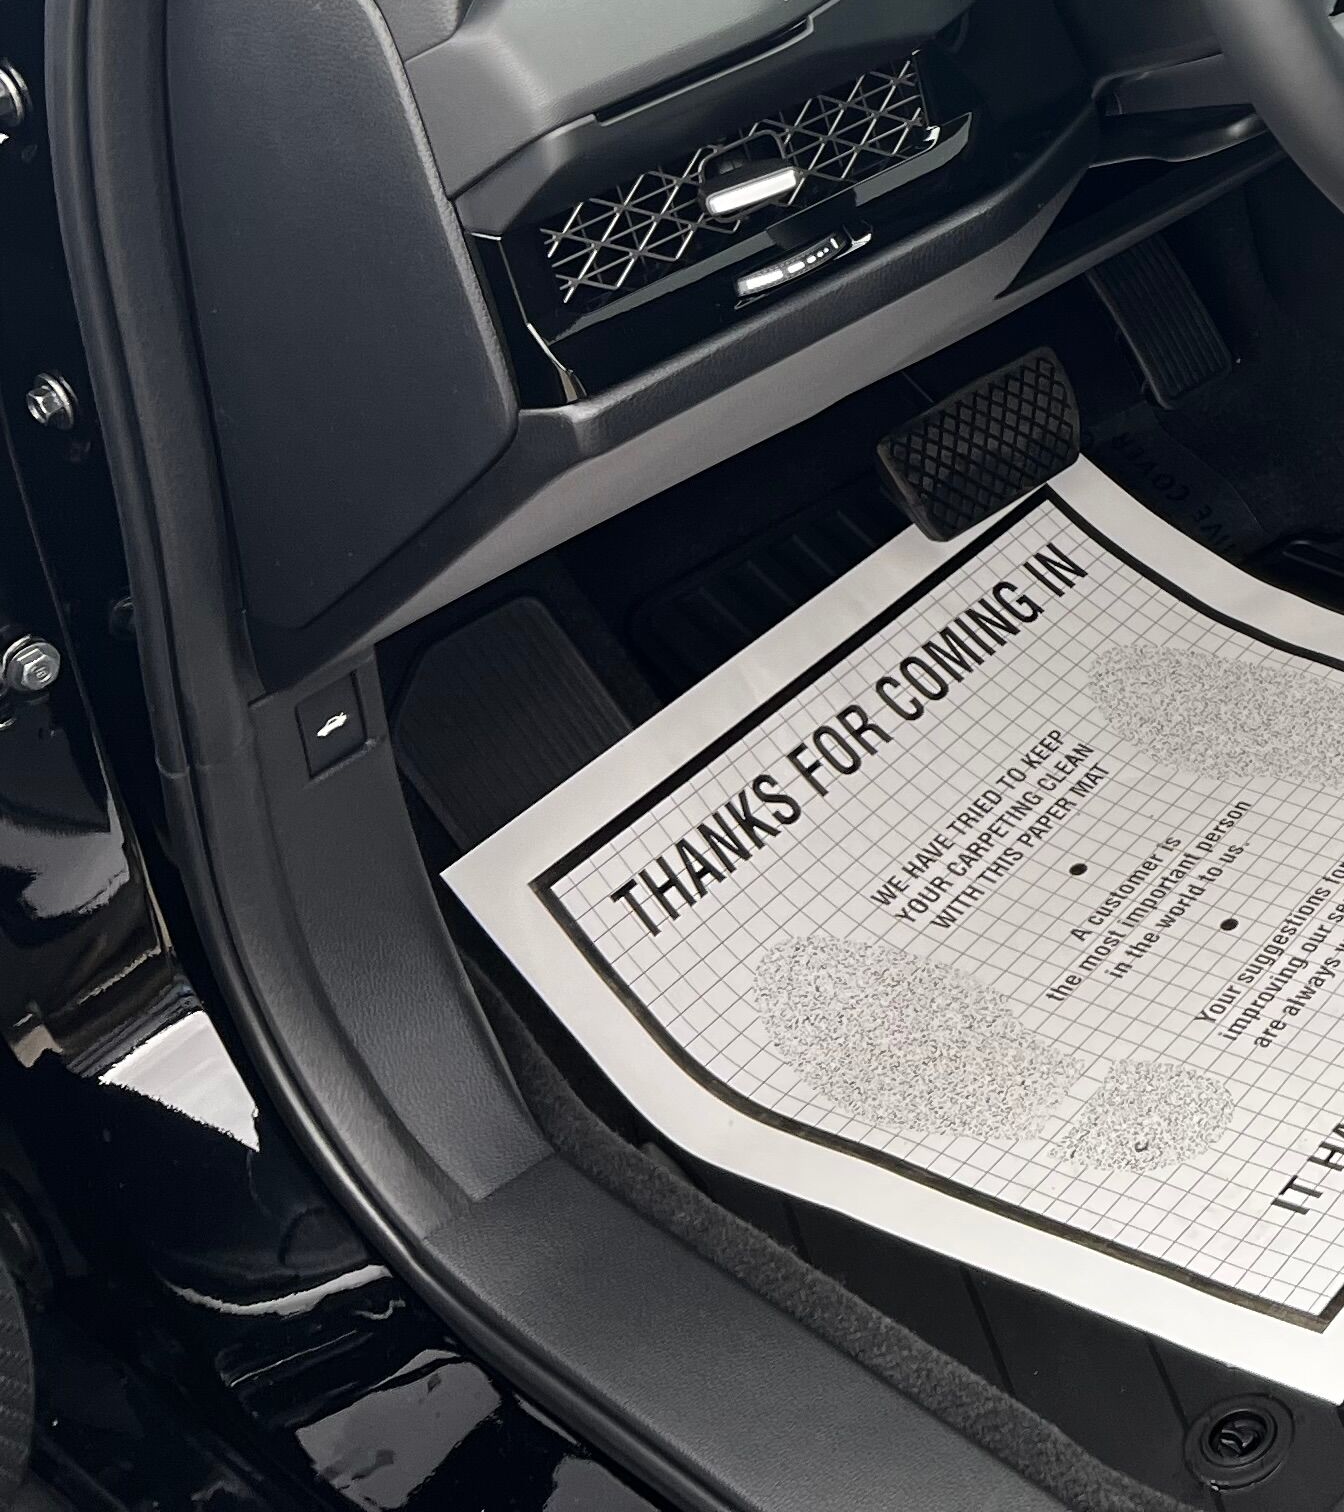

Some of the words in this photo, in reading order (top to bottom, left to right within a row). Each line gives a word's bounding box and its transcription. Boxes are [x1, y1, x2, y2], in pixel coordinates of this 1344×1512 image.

[611, 775, 801, 936] THANKS
[788, 705, 893, 797] FOR
[875, 581, 1044, 721] COMING
[1024, 543, 1088, 597] IN
[870, 875, 906, 906] WE
[902, 834, 955, 878] HAVE
[946, 790, 1003, 835] TRIED
[996, 767, 1026, 790] TO
[1020, 729, 1063, 768] KEEP
[896, 877, 954, 924] YOUR
[947, 791, 1043, 878] CARPETING
[1037, 743, 1094, 791] CLEAN
[929, 885, 985, 929] WITH
[977, 848, 1023, 886] THIS
[1017, 797, 1076, 849] PAPER
[1069, 763, 1109, 797] MAT
[1046, 974, 1082, 1002] the
[1079, 928, 1127, 972] most
[1120, 853, 1200, 929] important
[1196, 799, 1251, 852] person
[1070, 927, 1092, 942] A
[1087, 855, 1164, 926] customer
[1157, 837, 1181, 856] is
[1105, 960, 1132, 979] in
[1126, 931, 1160, 960] the
[1155, 883, 1206, 929] world
[1198, 865, 1223, 885] to
[1219, 842, 1249, 864] us.
[1194, 985, 1241, 1025] Your
[1238, 887, 1331, 984] suggestions
[1219, 957, 1309, 1040] improving
[1301, 924, 1333, 954] our
[1254, 1020, 1287, 1048] are
[1283, 957, 1341, 1017] always
[1271, 1175, 1323, 1215] IT
